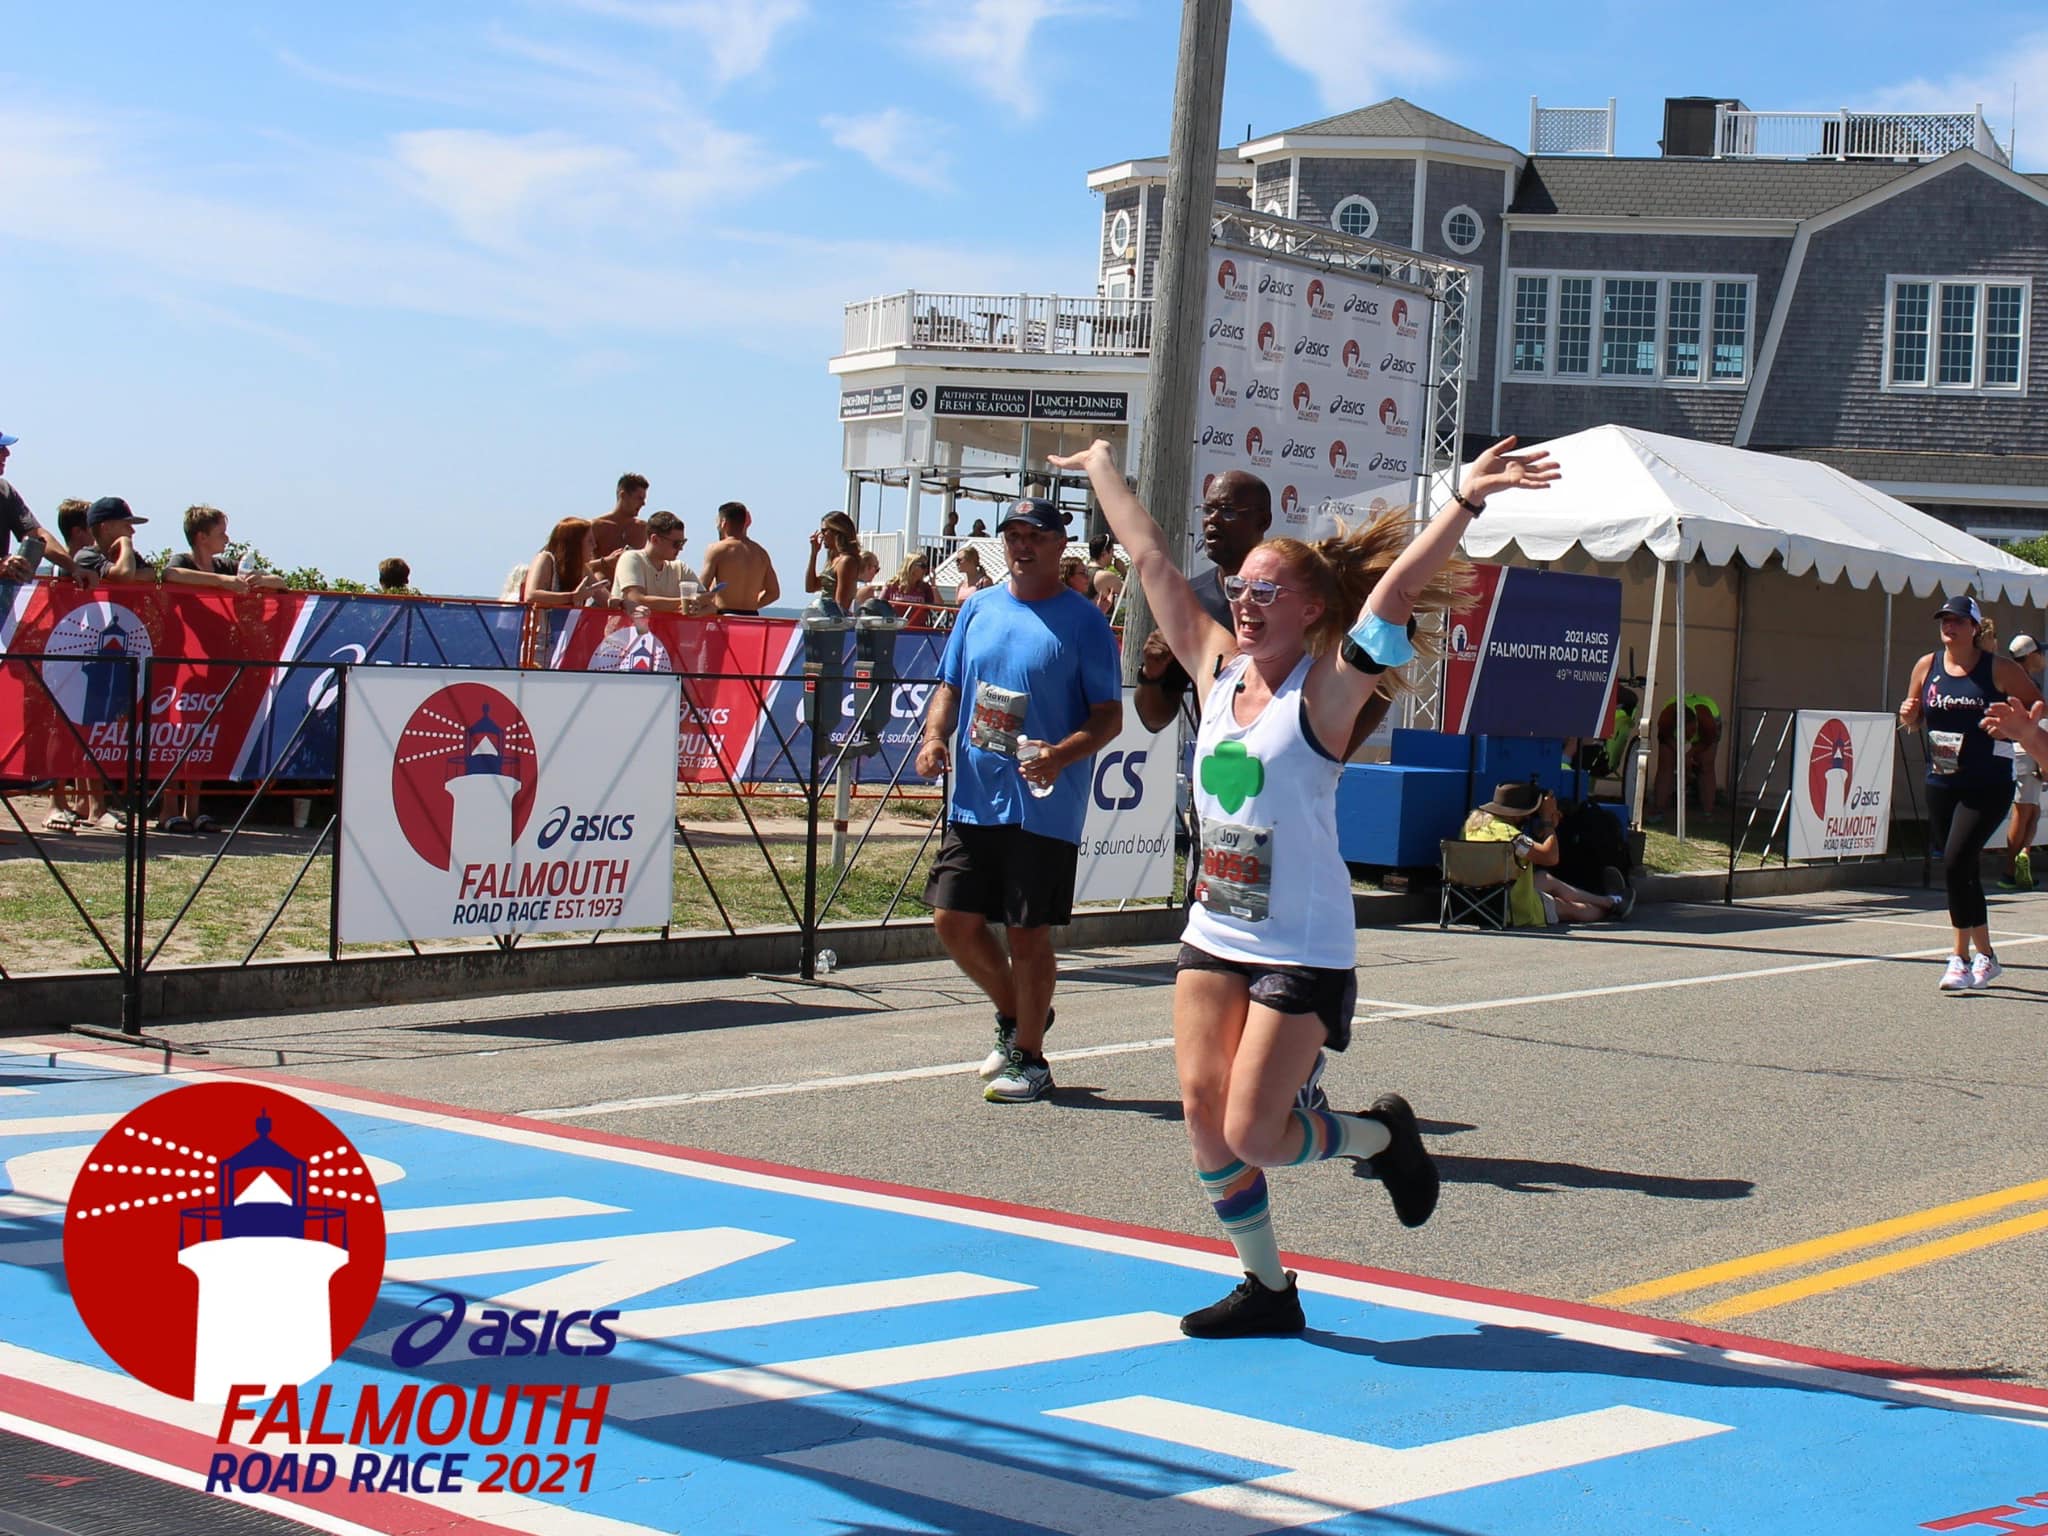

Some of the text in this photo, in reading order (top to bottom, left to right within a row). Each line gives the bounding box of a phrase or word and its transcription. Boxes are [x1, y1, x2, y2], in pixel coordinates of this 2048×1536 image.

[942, 390, 1024, 401] AUTHENTIC ITALIAN
[939, 399, 1025, 413] FRESH SEAFOOD
[1043, 408, 1117, 417] Nightly Entertainment
[1565, 630, 1609, 645] 2021 ASICS
[1489, 641, 1547, 660] FALMOUTH
[1549, 646, 1579, 662] ROAD
[1581, 649, 1609, 664] RACE
[1573, 670, 1608, 682] RUNNING
[986, 688, 1010, 703] Gavin
[1861, 790, 1880, 806] asics
[570, 814, 635, 842] asics
[1825, 815, 1878, 837] FALMOUTH
[1094, 833, 1136, 856] sound
[1136, 833, 1170, 858] body
[1220, 828, 1240, 847] Joy
[458, 859, 630, 900] FALMOUTH
[452, 901, 502, 924] ROAD
[506, 899, 550, 922] RACE
